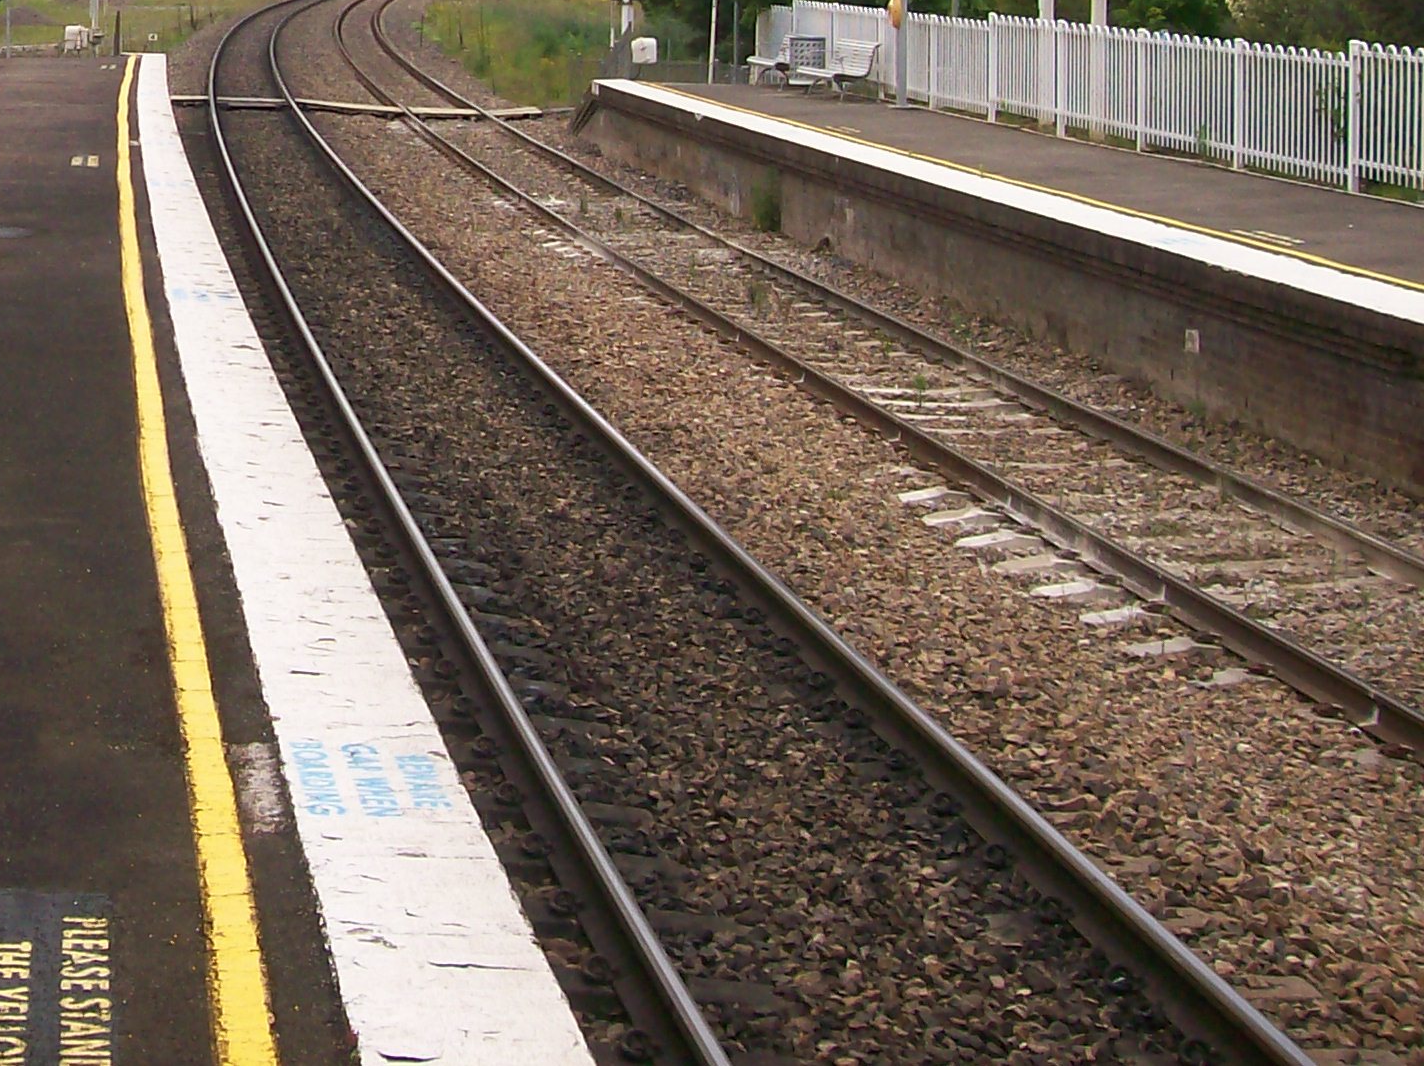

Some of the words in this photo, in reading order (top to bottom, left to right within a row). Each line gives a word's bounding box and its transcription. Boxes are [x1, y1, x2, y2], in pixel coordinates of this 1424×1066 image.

[289, 741, 347, 816] BOARDING
[352, 777, 404, 818] WHEN
[60, 916, 112, 991] PLEASE
